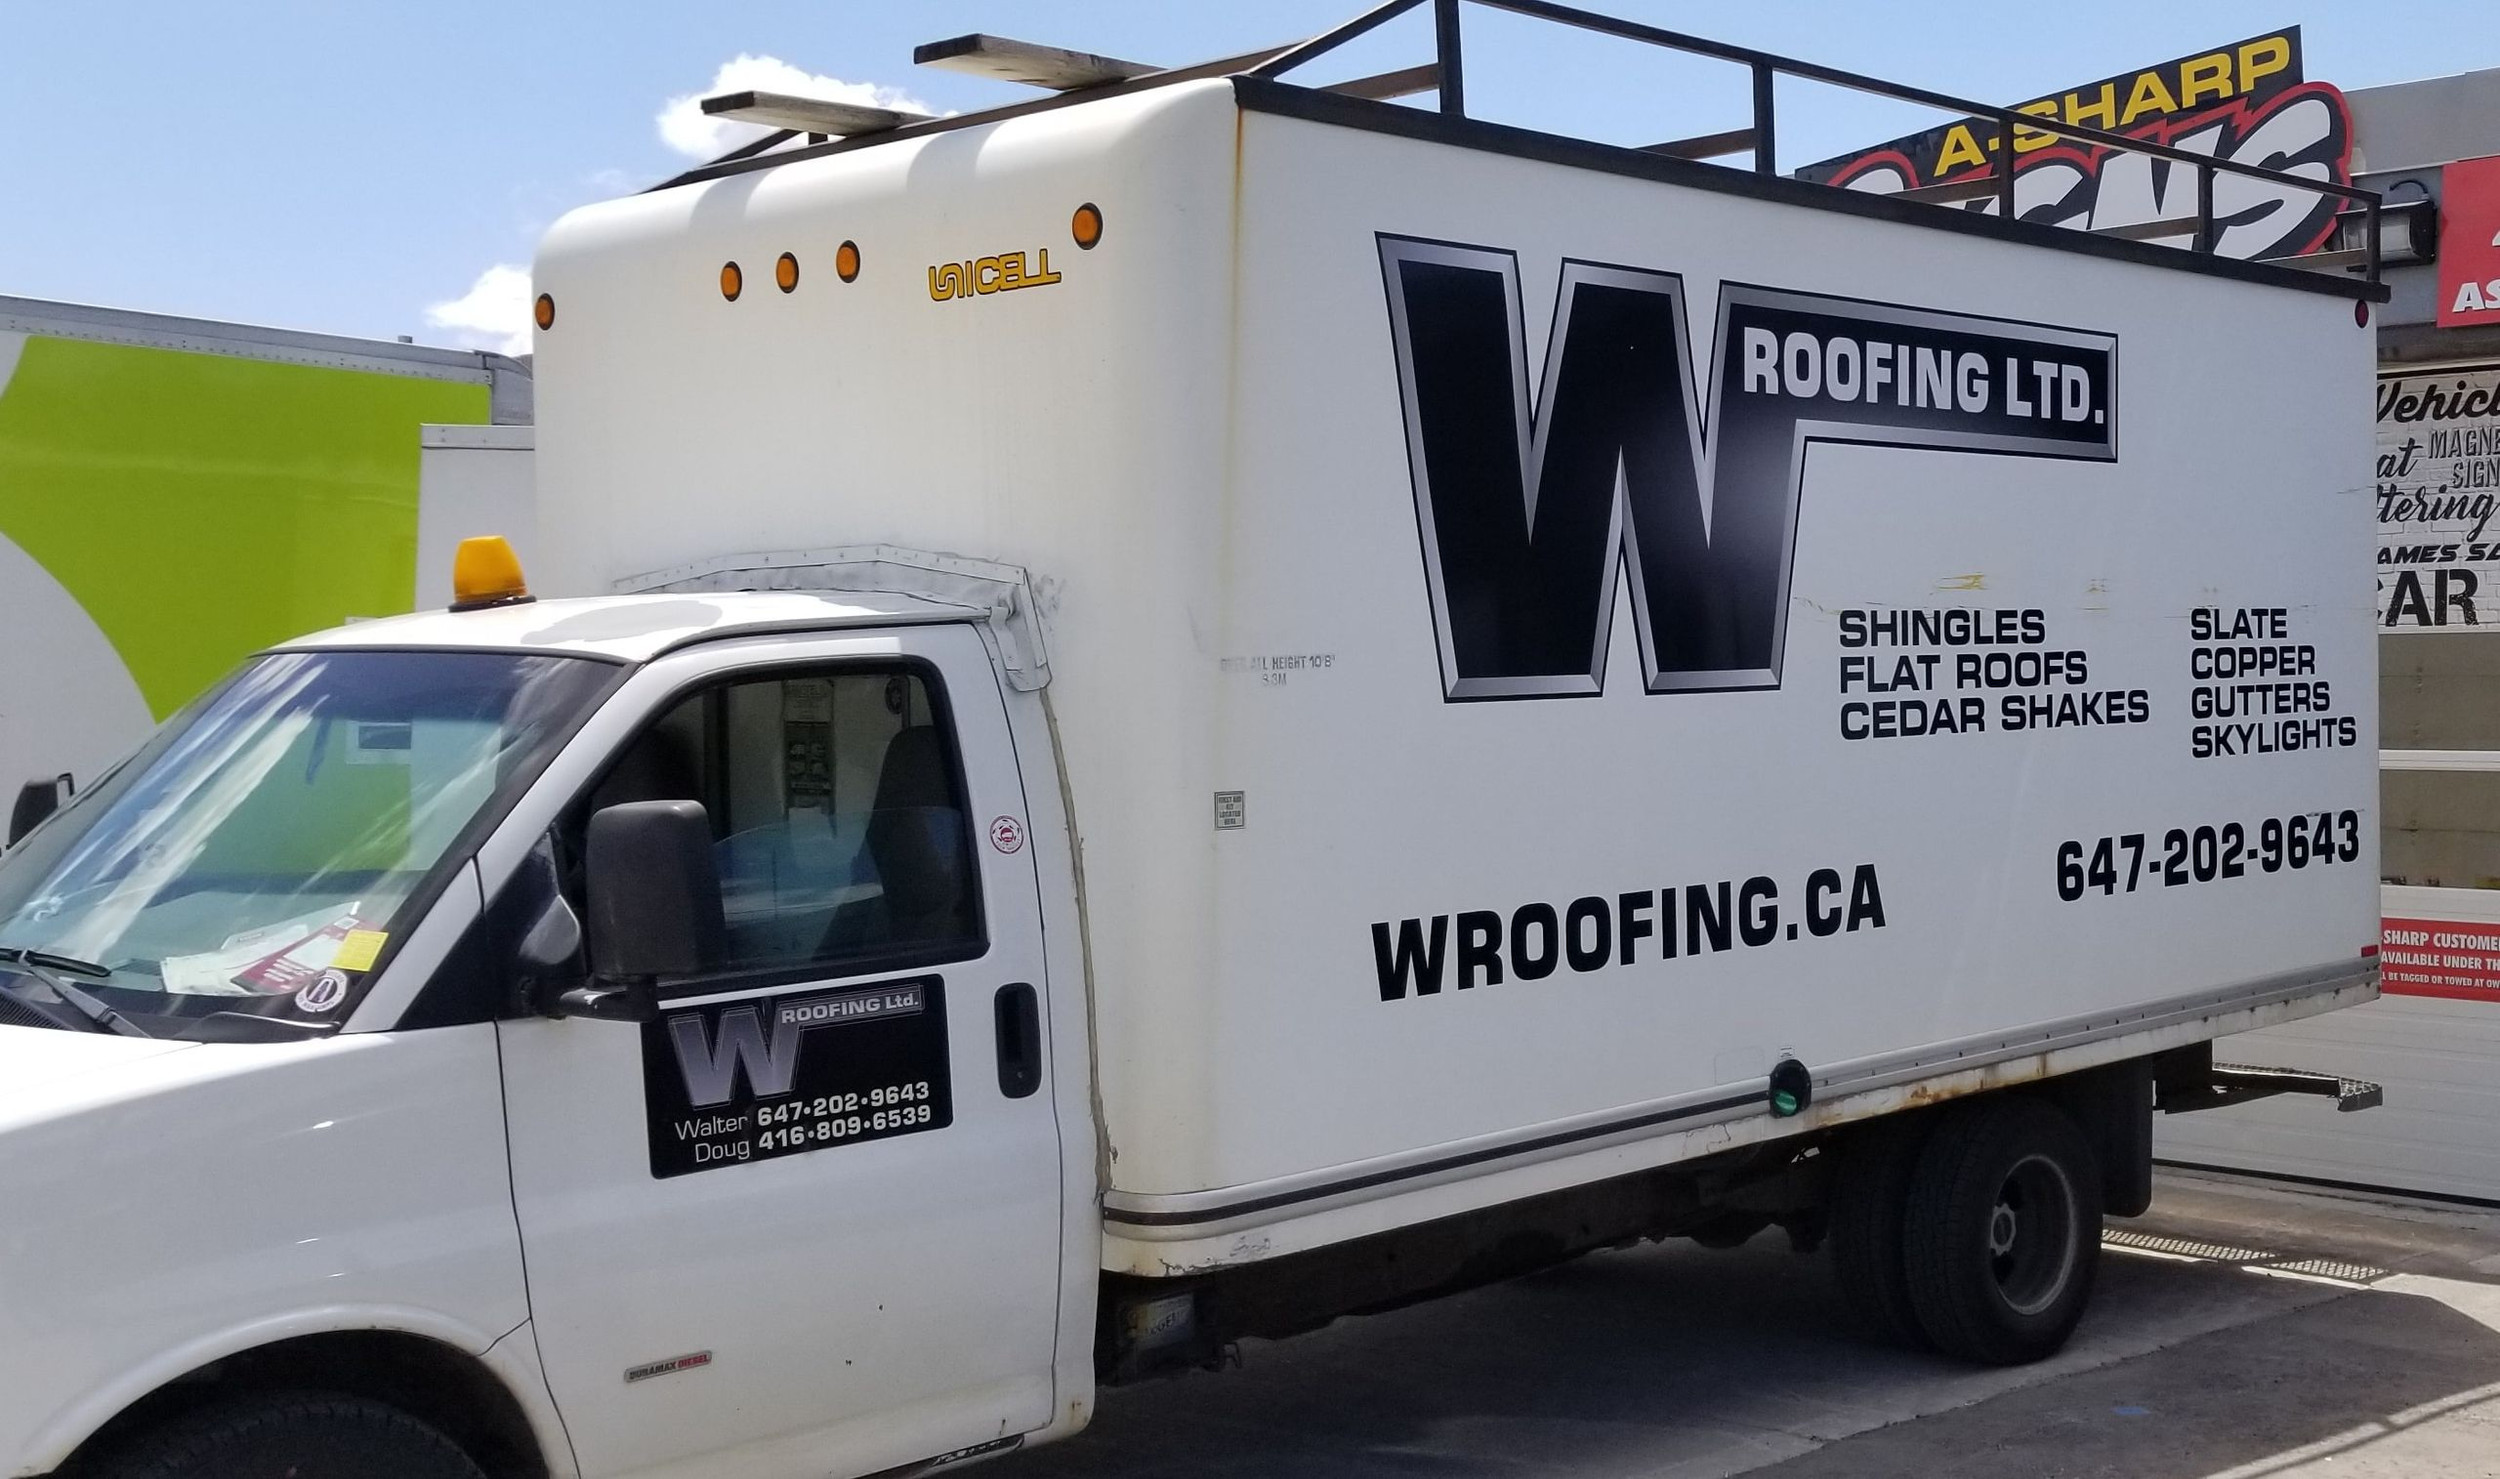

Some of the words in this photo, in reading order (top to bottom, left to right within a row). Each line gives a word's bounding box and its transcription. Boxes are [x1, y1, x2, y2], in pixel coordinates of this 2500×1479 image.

[1933, 36, 2290, 178] A-SHARP
[928, 248, 1062, 302] UNICELL
[1743, 326, 1990, 413] ROOFING
[2006, 357, 2104, 424] LTD.
[2378, 568, 2479, 627] AR
[1839, 609, 2046, 647] SHINGLES
[2190, 607, 2288, 640] SLATE
[1272, 655, 1306, 670] HEIGHT
[1840, 655, 1940, 693] FLAT
[1956, 651, 2087, 689] ROOFS
[2190, 645, 2316, 679] COPPER
[1840, 698, 1986, 740] CEDAR
[2001, 690, 2150, 730] SHAKES
[2190, 681, 2331, 718] GUTTERS
[2191, 717, 2357, 758] SKYLIGHTS
[2056, 810, 2360, 902] 647-202-9643
[1371, 863, 1887, 1002] WROOFING.CA
[2381, 951, 2440, 966] AVAILABLE
[2443, 955, 2482, 969] UNDER
[2400, 973, 2429, 983] TAGGED
[2432, 975, 2443, 984] OR
[2445, 977, 2472, 986] TOWED
[2474, 979, 2484, 987] AT
[781, 997, 881, 1024] ROOFING
[885, 992, 919, 1010] Ltd.
[675, 1114, 749, 1141] Walter
[695, 1140, 750, 1164] Doug
[629, 1361, 677, 1380] DURAMAX
